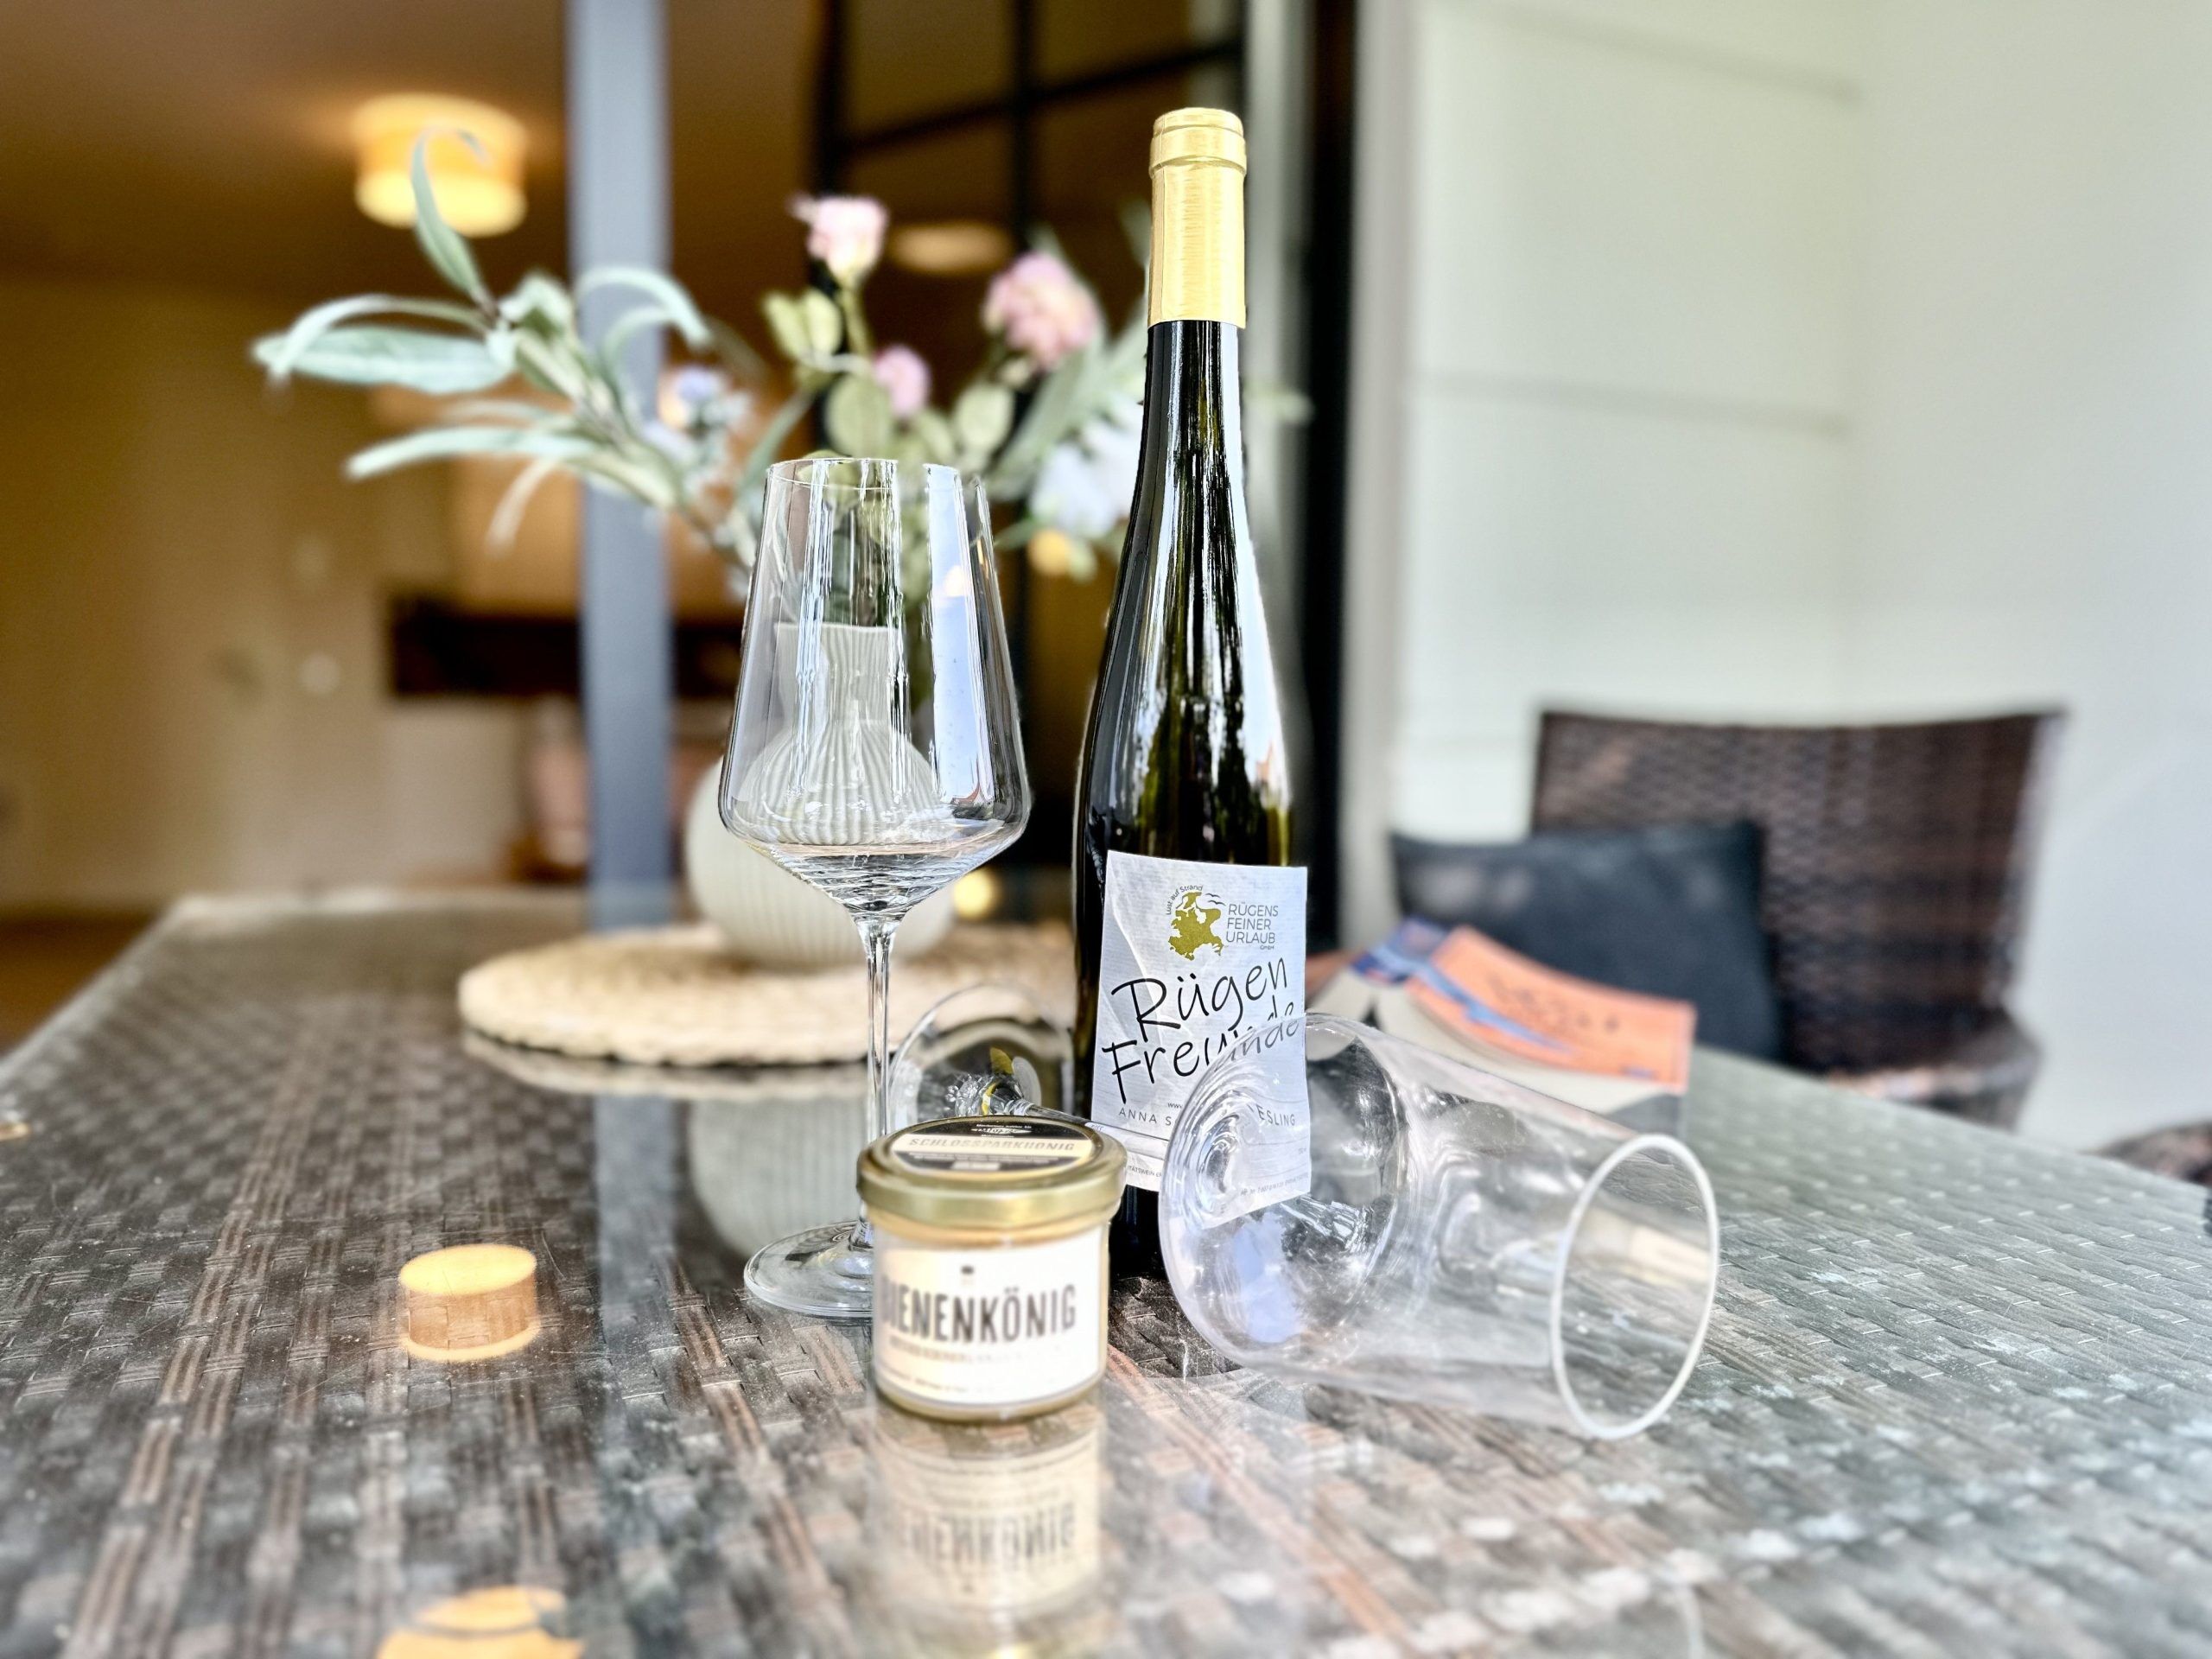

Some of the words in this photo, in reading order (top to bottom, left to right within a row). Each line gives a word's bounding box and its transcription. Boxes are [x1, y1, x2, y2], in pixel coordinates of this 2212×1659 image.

[1170, 889, 1180, 900] auf
[1228, 901, 1279, 917] RÜGENS
[1227, 917, 1271, 931] FEINER
[1225, 931, 1275, 944] URLAUB
[1110, 957, 1287, 1043] Rügen
[1118, 1107, 1157, 1124] ANNA
